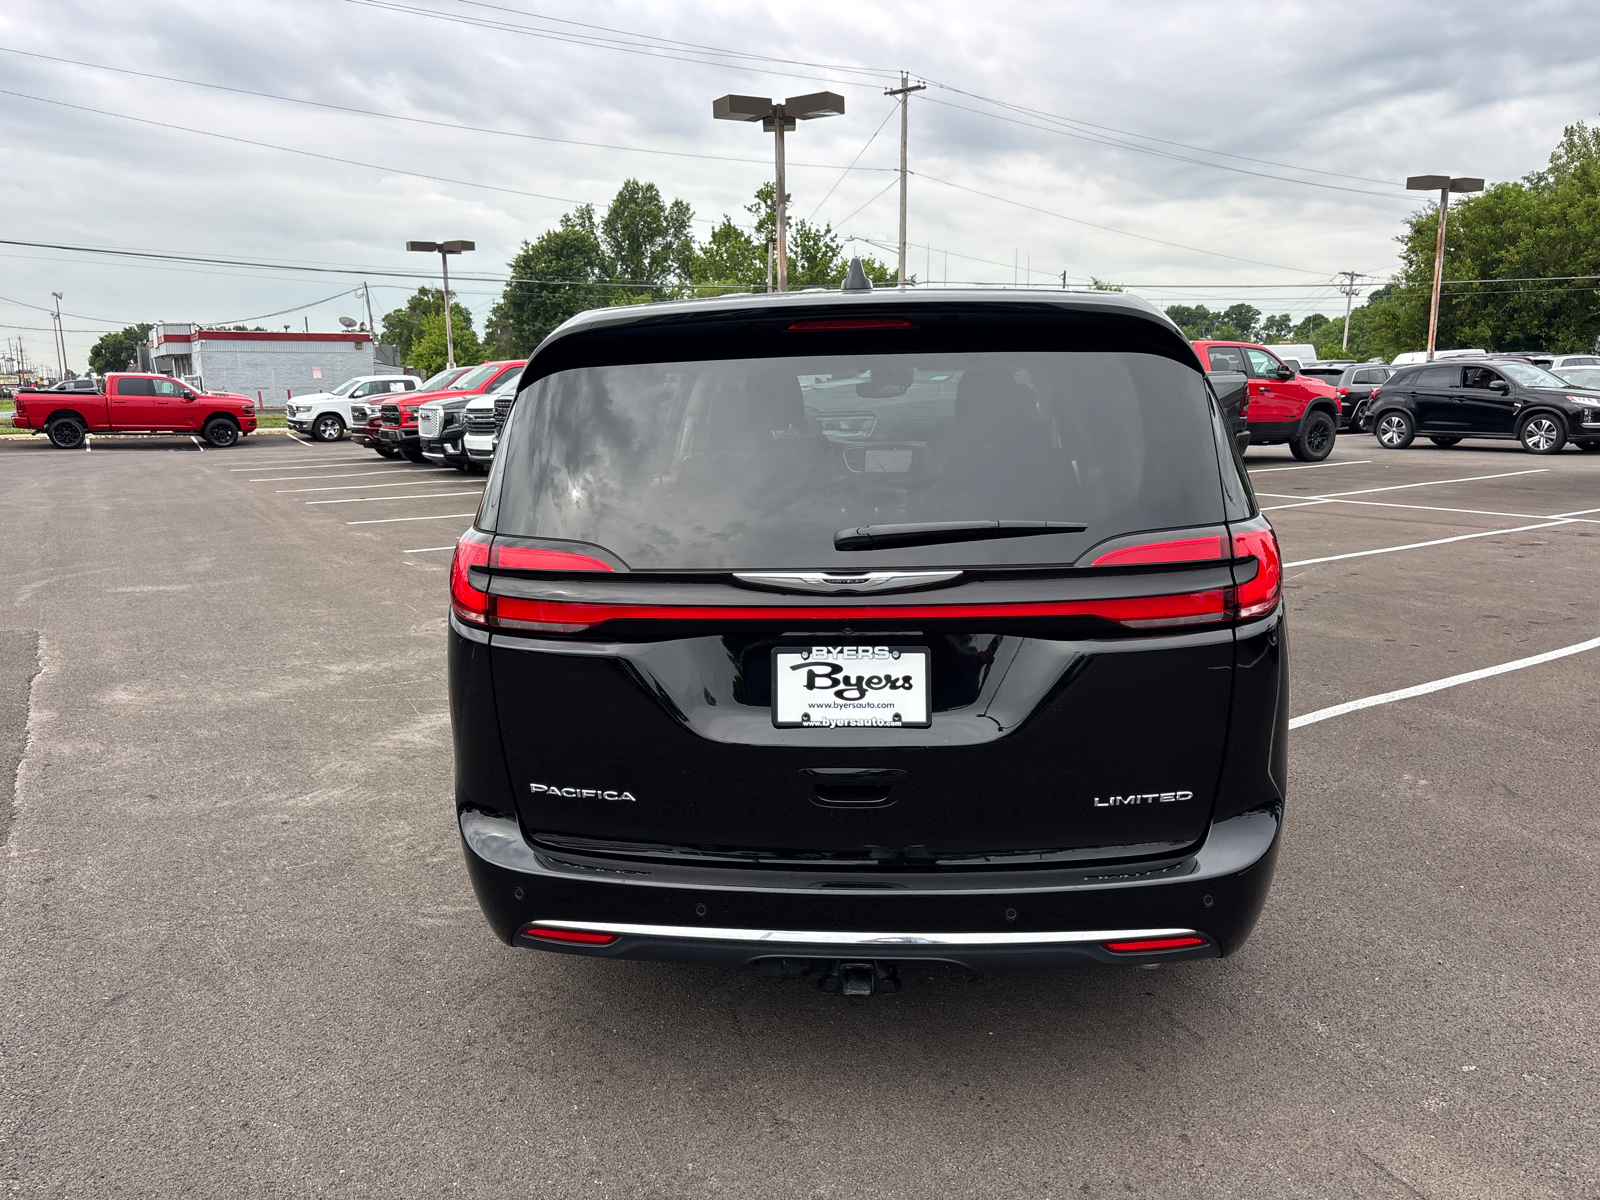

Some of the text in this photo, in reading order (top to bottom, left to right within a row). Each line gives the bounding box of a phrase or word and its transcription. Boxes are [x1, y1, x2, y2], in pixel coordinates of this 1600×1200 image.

[812, 646, 890, 660] BYERS
[789, 661, 913, 701] Byers
[808, 701, 895, 710] www.byersauto.com
[802, 716, 902, 729] www.byersauto.com
[530, 783, 636, 802] PACIFICA
[1094, 791, 1193, 807] LIMITED
